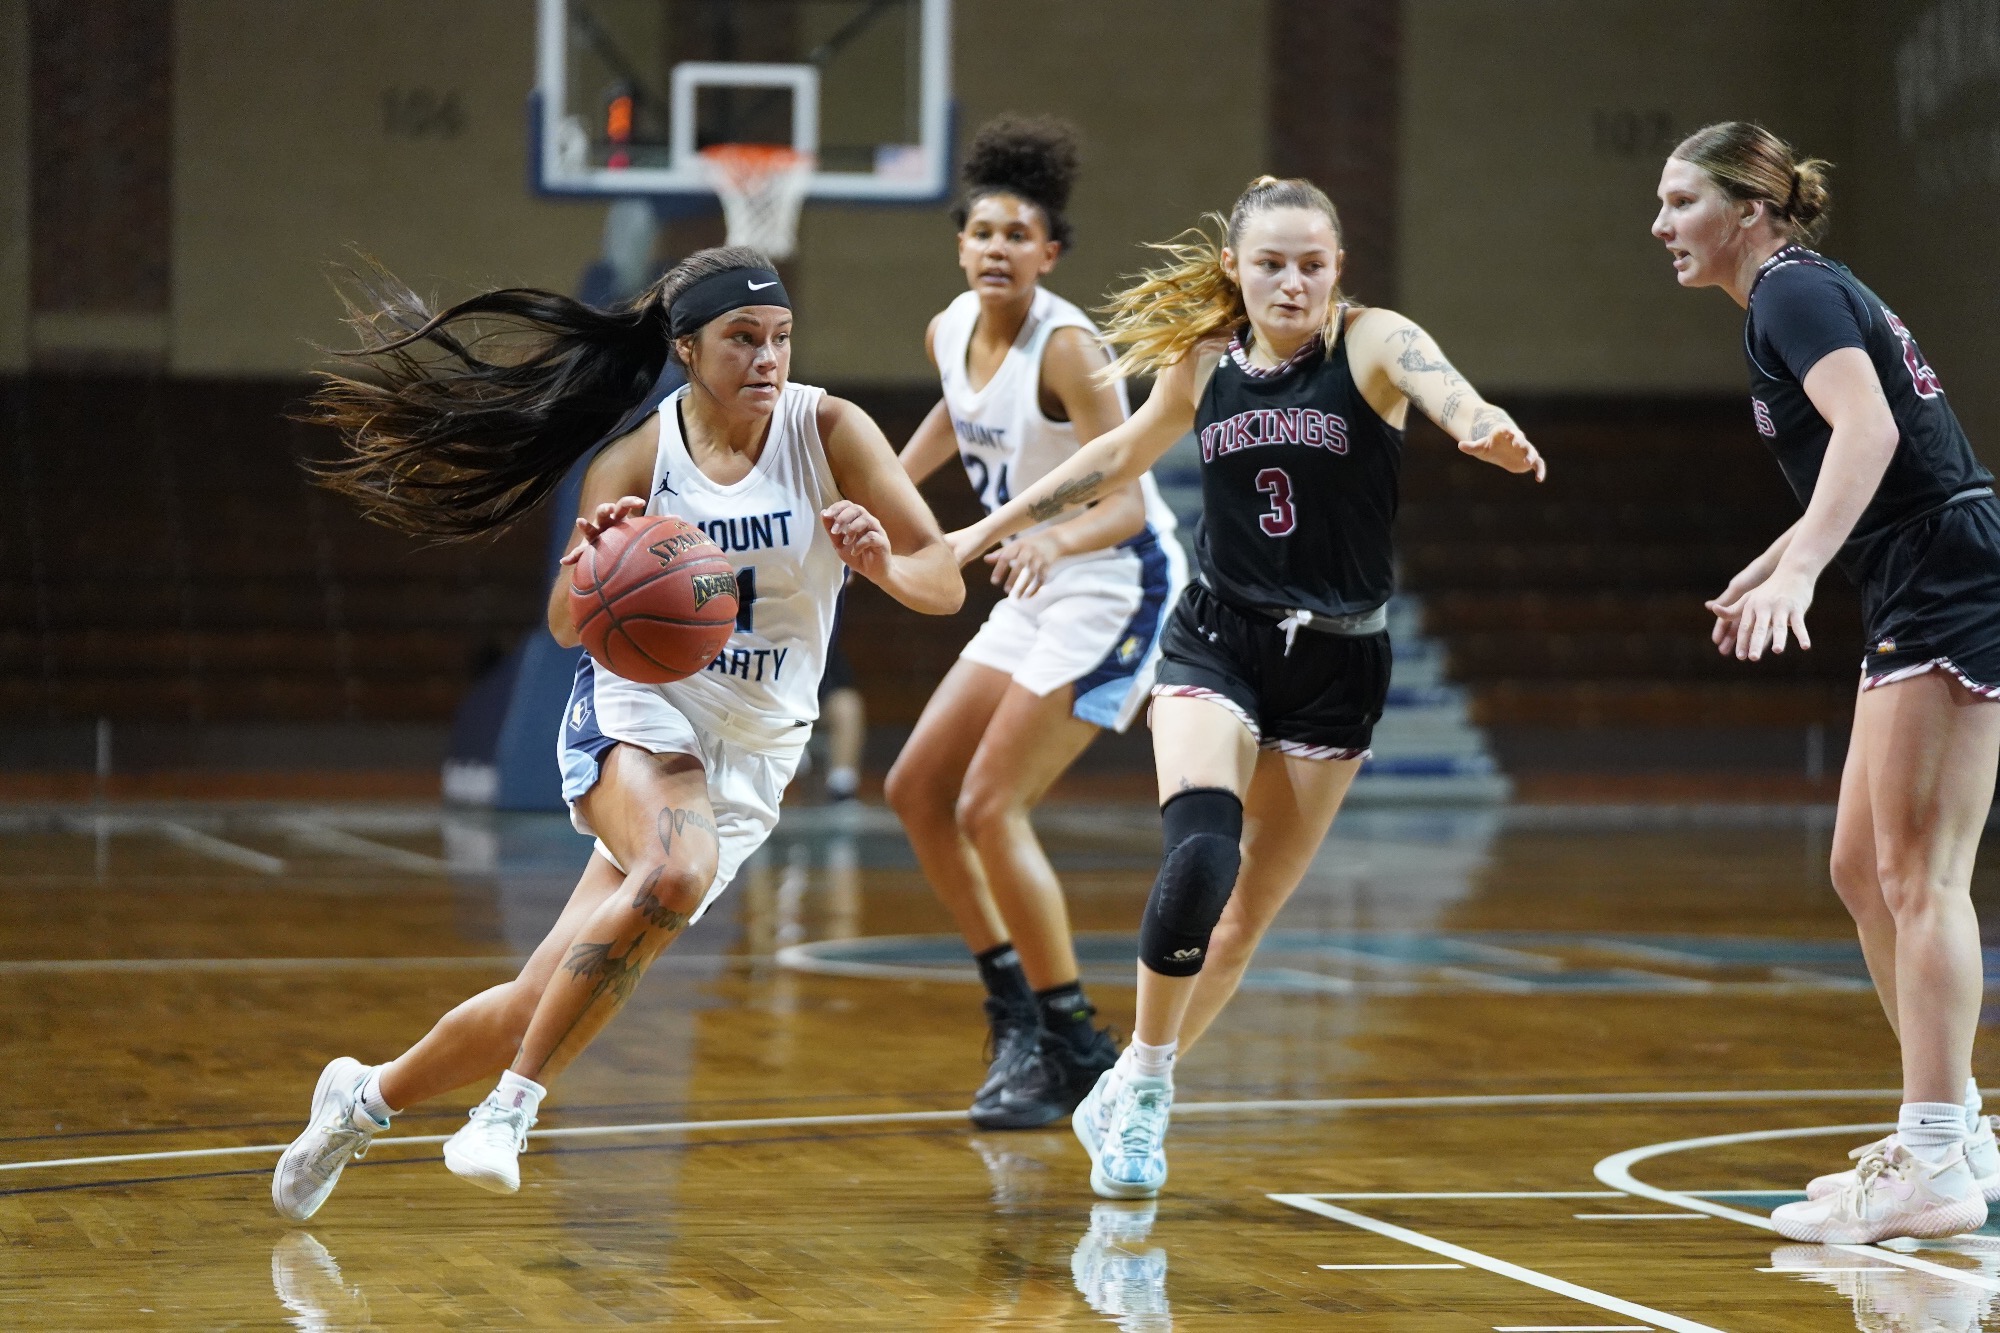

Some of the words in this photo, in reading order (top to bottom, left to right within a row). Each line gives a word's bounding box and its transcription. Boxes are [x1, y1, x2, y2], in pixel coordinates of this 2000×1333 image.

[1201, 408, 1347, 463] VIKINGS
[1255, 467, 1297, 537] 3
[706, 647, 788, 682] ARTY
